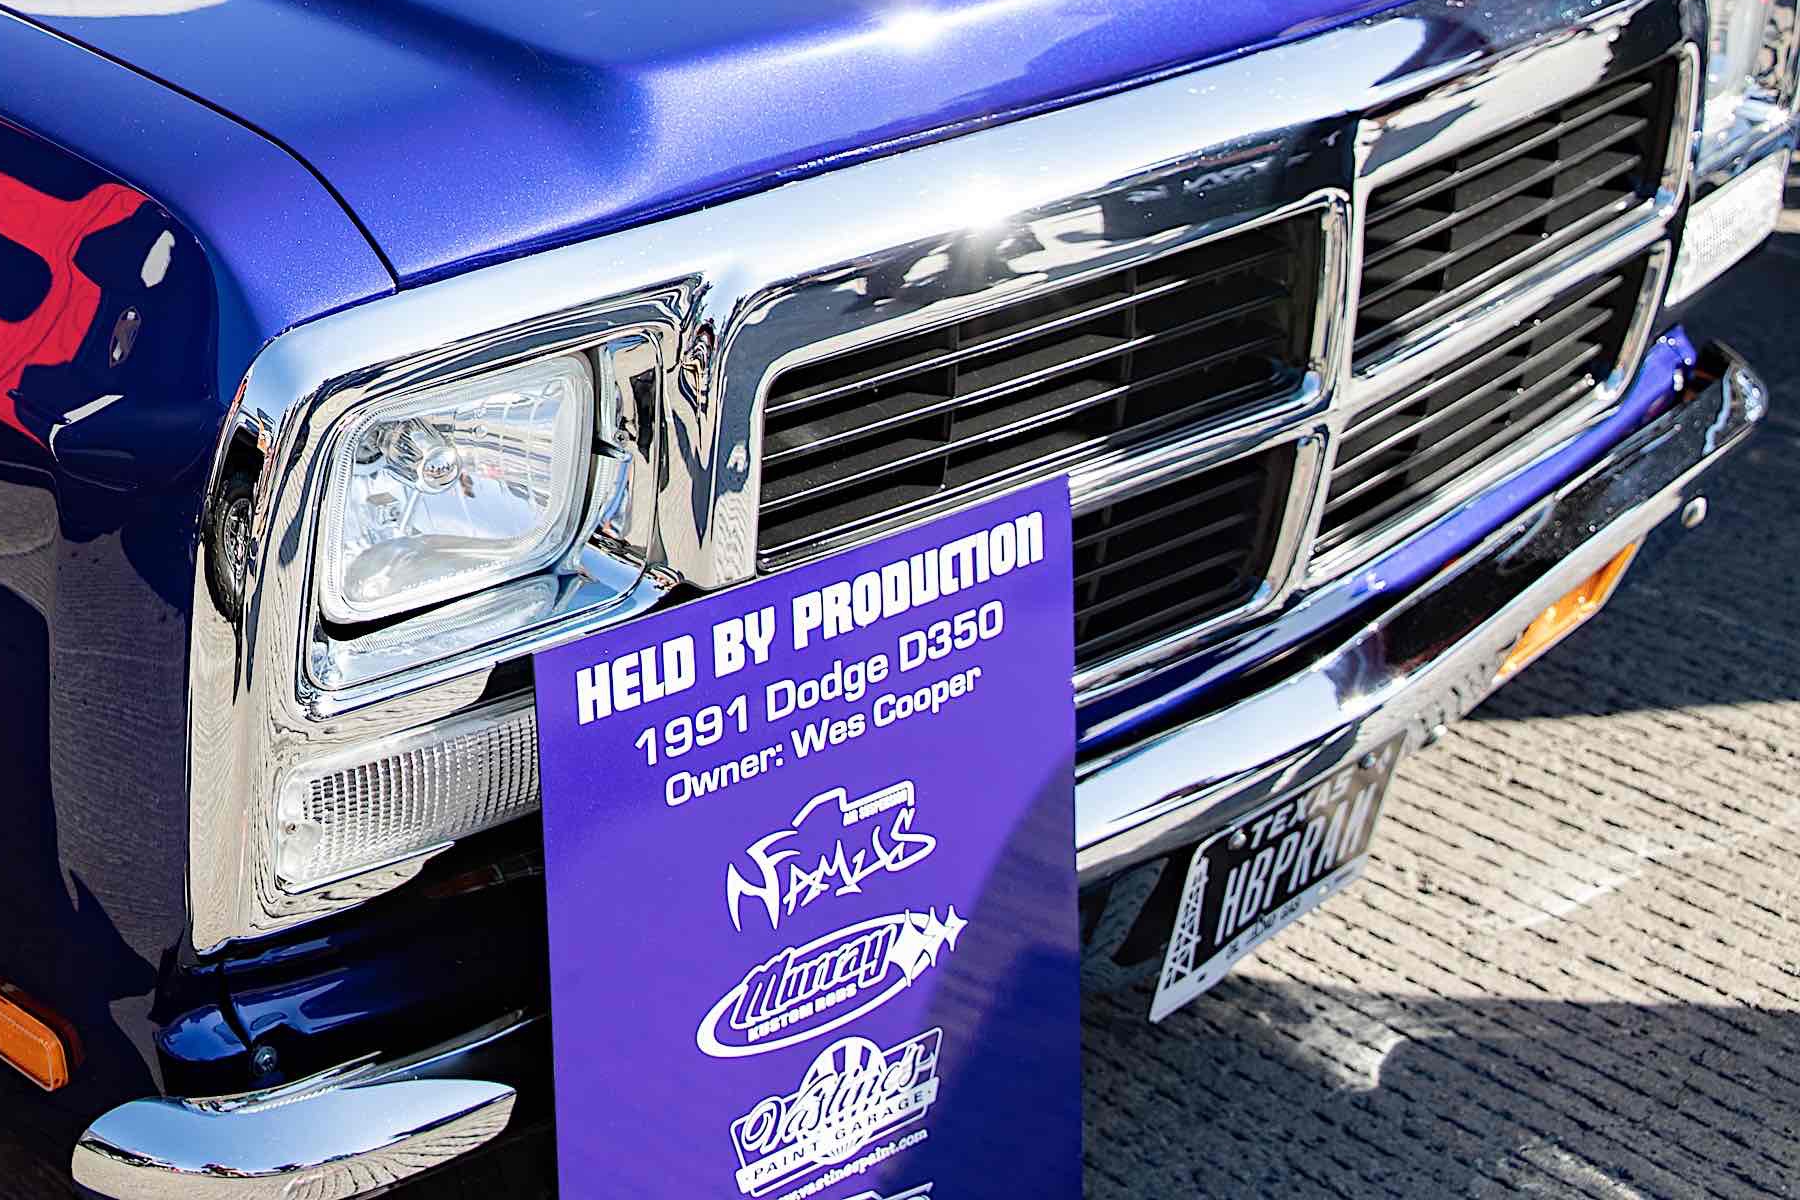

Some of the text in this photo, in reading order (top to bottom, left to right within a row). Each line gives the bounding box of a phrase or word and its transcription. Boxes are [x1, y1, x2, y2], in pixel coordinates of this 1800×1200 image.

[576, 511, 1045, 726] HELD BY PRODUCTION
[634, 600, 1005, 767] 1991 Dodge D350
[665, 743, 784, 808] Owner:
[790, 712, 866, 759] Wes
[872, 666, 982, 728] Cooper
[1250, 767, 1354, 850] TEXAS
[747, 1000, 814, 1043] KUSTOM
[752, 1089, 927, 1181] PAINT GARAGE
